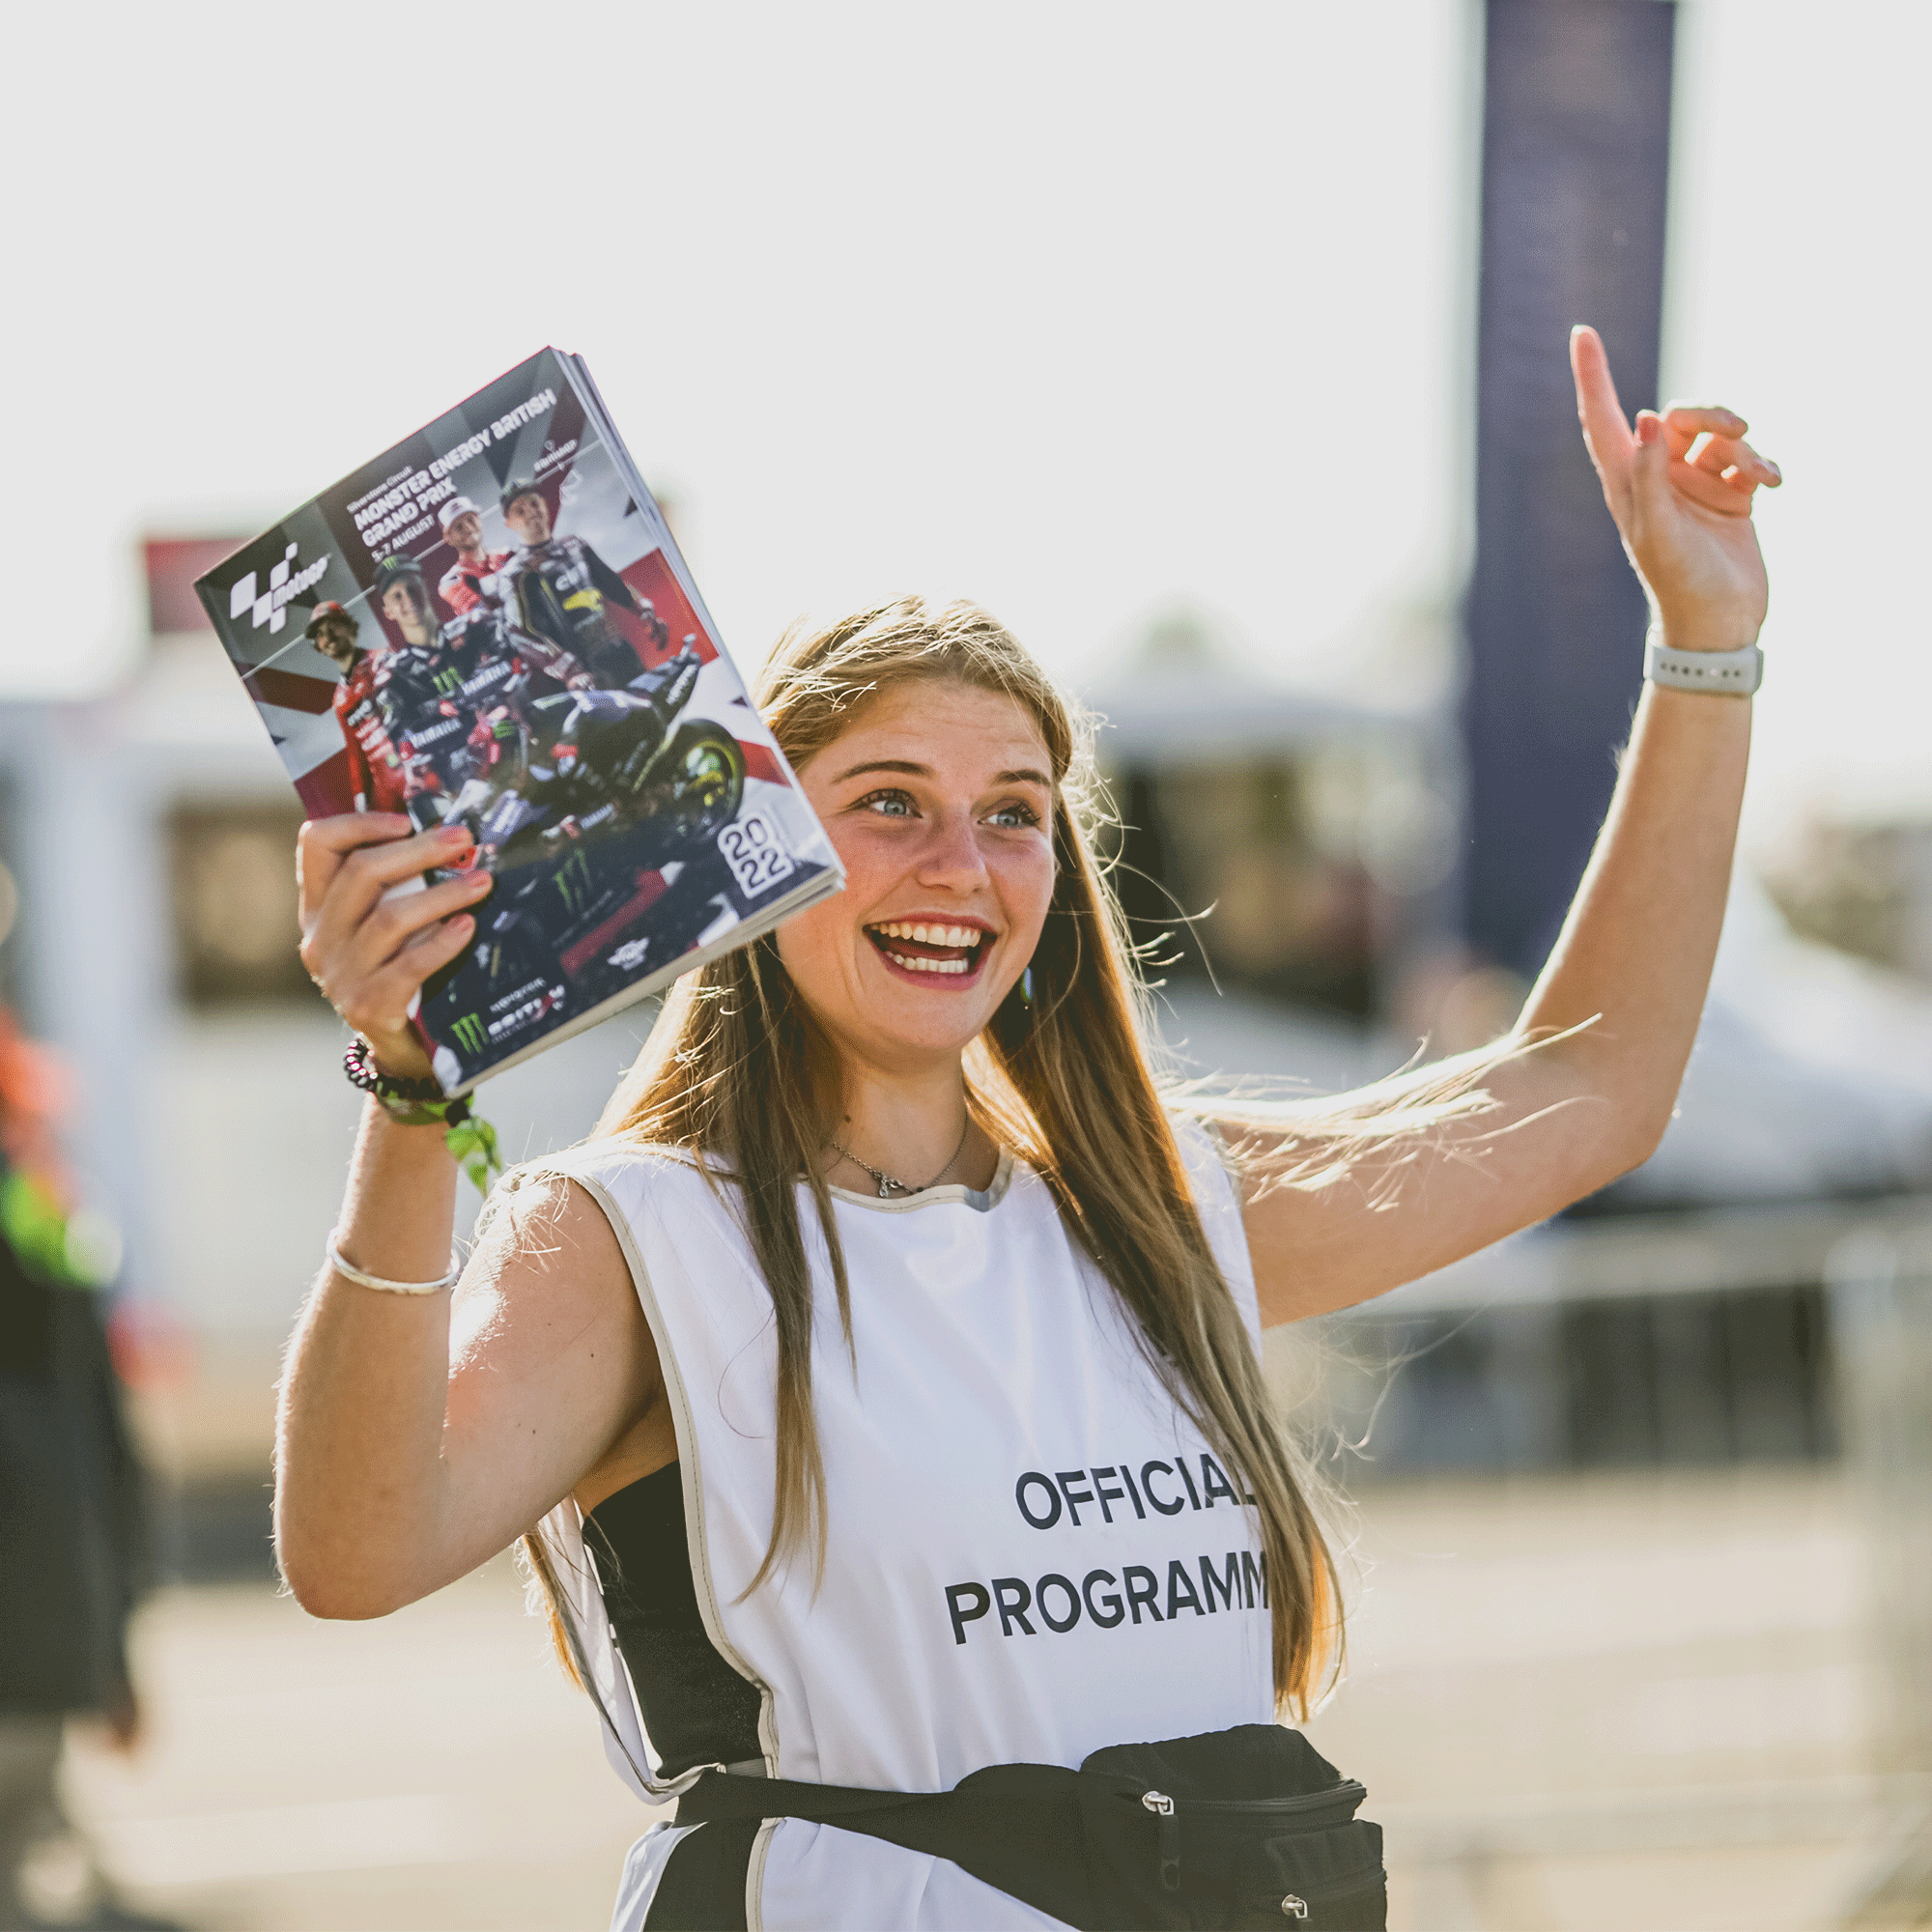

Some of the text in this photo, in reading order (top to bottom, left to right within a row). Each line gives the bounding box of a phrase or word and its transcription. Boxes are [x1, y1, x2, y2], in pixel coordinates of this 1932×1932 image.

[354, 387, 557, 531] MONSTER ENERGY BRITISH
[347, 482, 387, 514] Silverstone
[361, 475, 458, 548] GRAND PRIX
[392, 513, 435, 551] AUGUST
[724, 817, 768, 862] 20
[740, 848, 787, 890] 22
